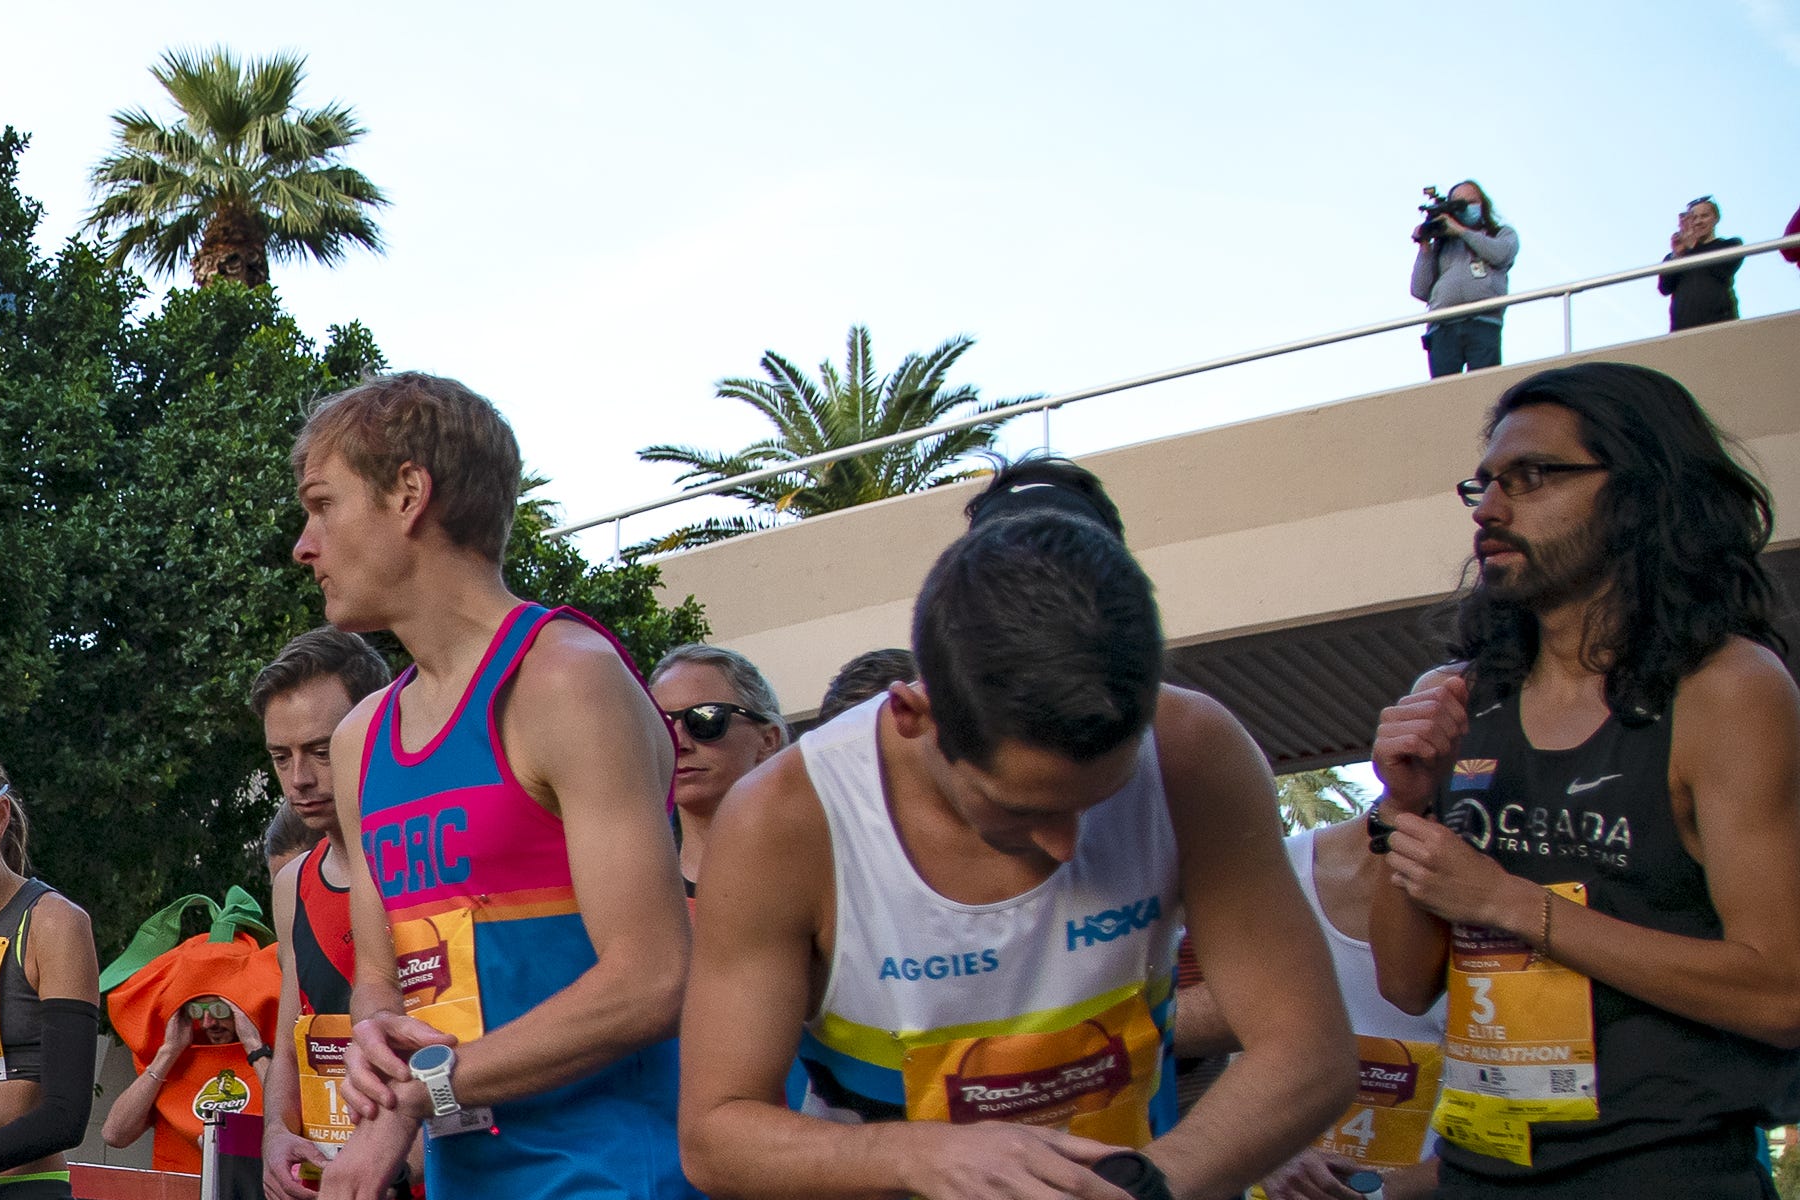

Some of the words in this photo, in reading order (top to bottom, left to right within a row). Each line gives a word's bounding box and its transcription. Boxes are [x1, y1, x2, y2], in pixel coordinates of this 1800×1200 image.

[1065, 895, 1161, 952] HOKA
[878, 948, 1000, 981] AGGIES
[407, 972, 433, 985] SERIES
[1466, 977, 1496, 1025] 3
[1467, 1023, 1507, 1041] ELITE
[1471, 1045, 1571, 1063] MARATHON
[977, 1093, 1050, 1113] RUNNING
[1052, 1075, 1106, 1098] SERIES
[1361, 1079, 1397, 1089] SERIES
[200, 1098, 245, 1110] Green
[1022, 1104, 1079, 1124] RIZONA
[1322, 1138, 1368, 1159] ELITE
